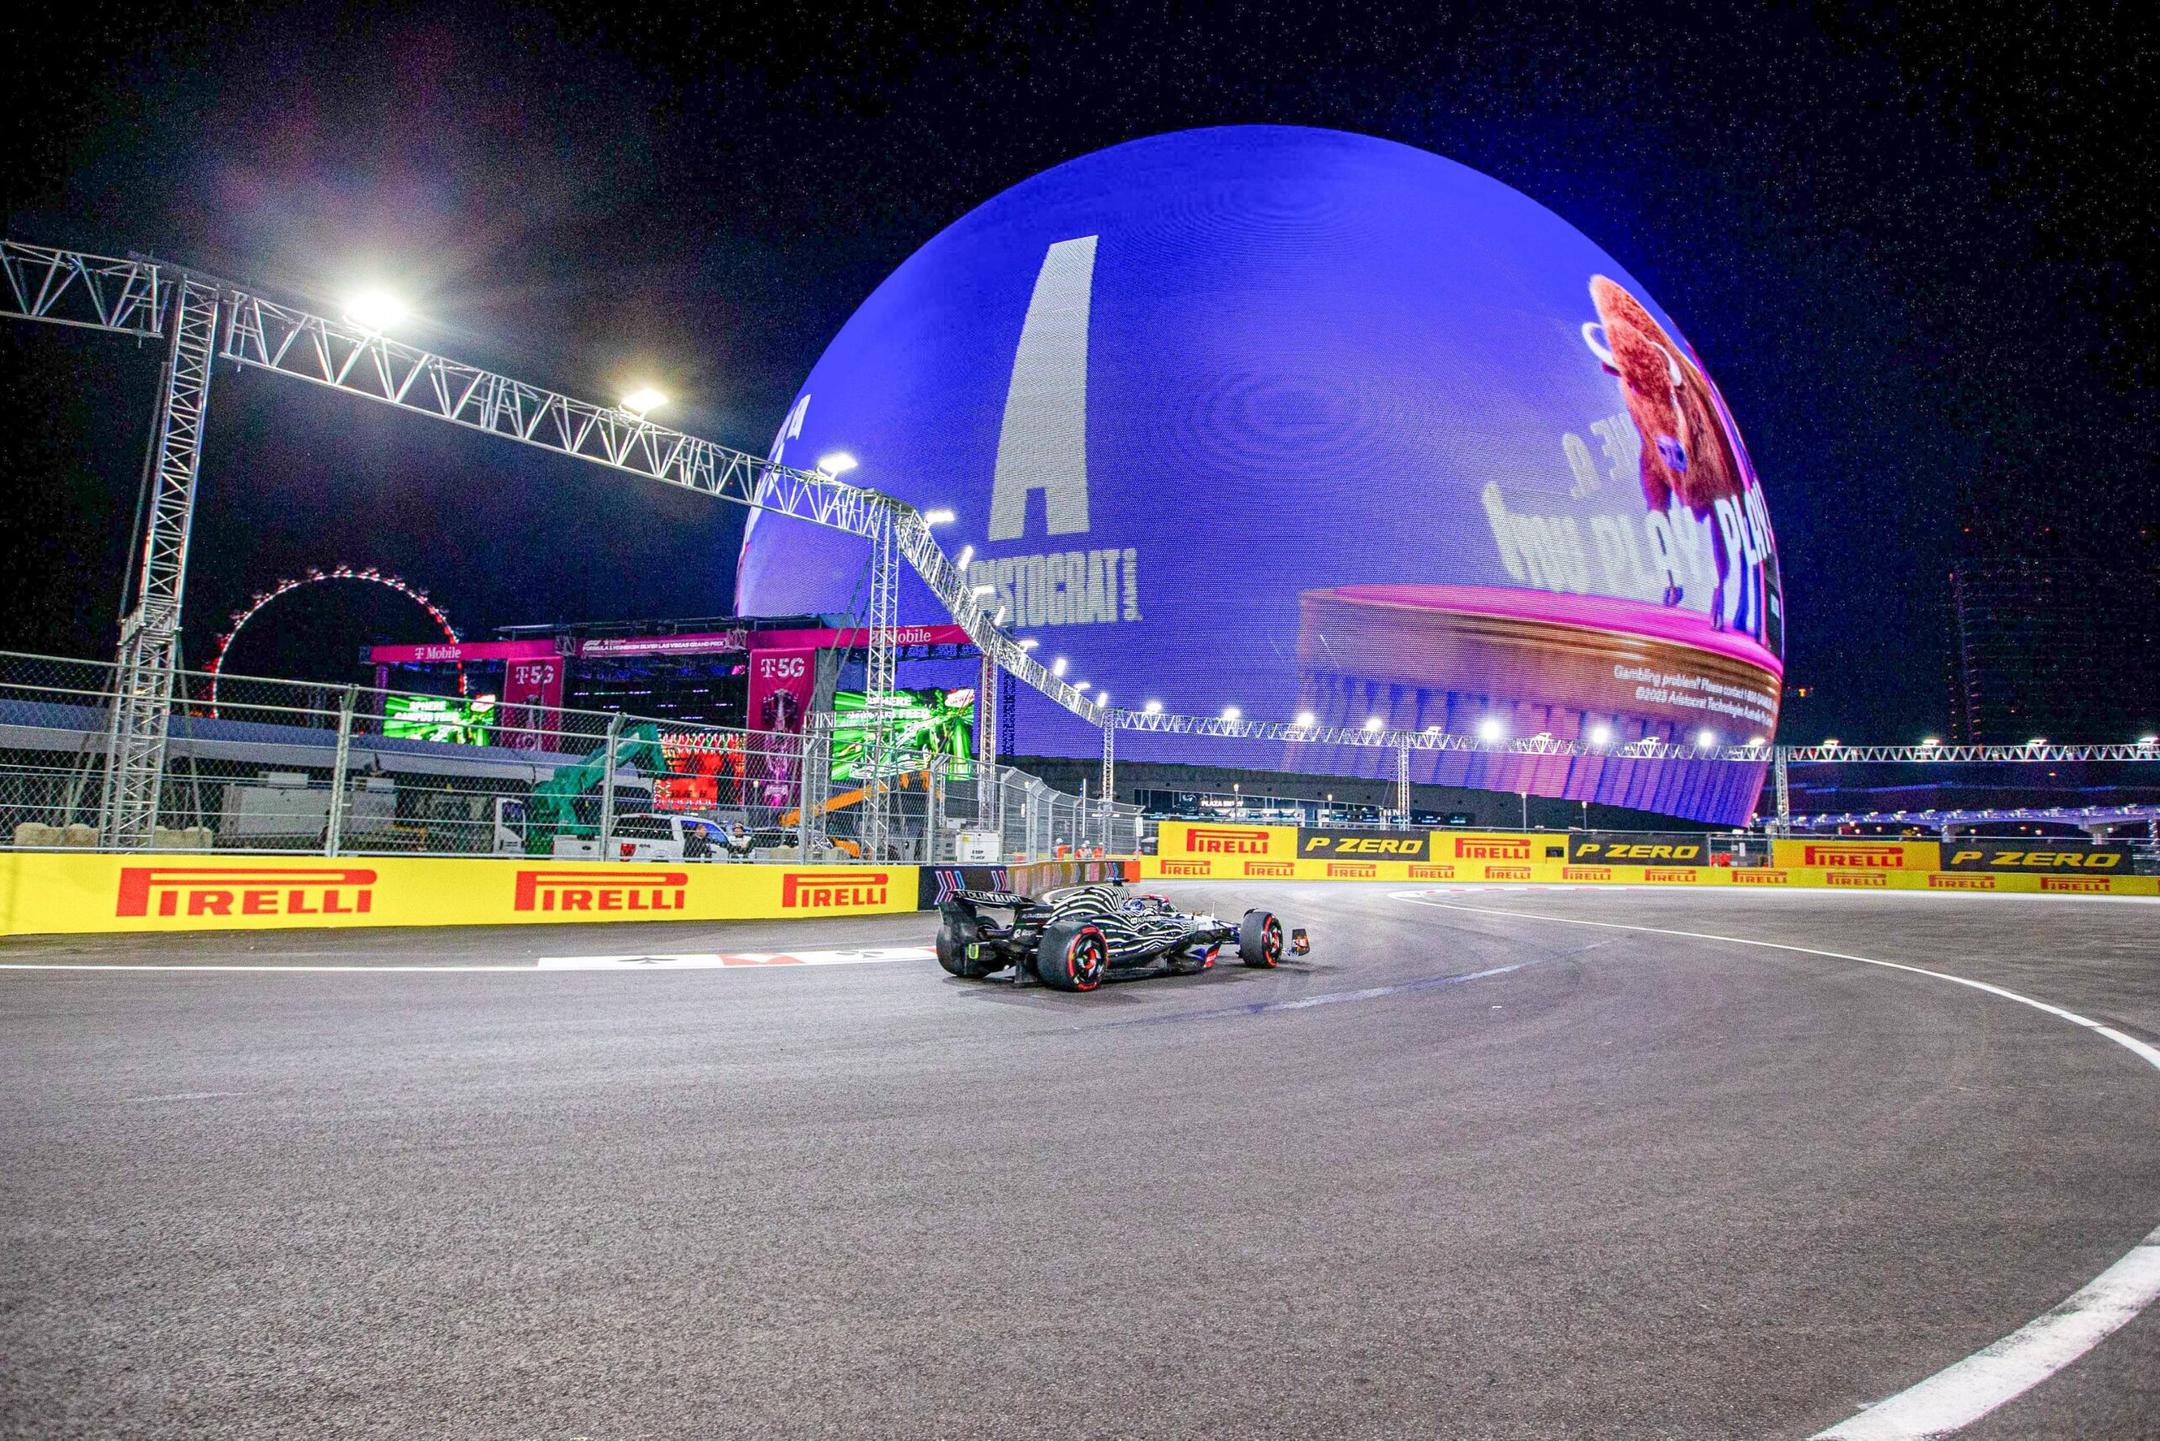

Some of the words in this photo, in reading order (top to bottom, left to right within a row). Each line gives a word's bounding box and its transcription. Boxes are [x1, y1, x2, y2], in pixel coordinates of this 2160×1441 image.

[962, 549, 1121, 627] RISTOCRAT
[1614, 664, 1662, 687] Gambling
[1187, 828, 1269, 854] PIRELLI
[1306, 837, 1331, 852] P
[1334, 838, 1424, 854] ZERO
[1456, 837, 1531, 859] PIRELLI
[1577, 843, 1601, 857] P
[1605, 844, 1700, 859] ZERO
[1804, 845, 1904, 868] PIRELLI
[1951, 851, 1983, 865] P
[1990, 852, 2121, 868] ZERO
[1161, 860, 1211, 875] PIRELLI
[1244, 861, 1294, 876] PIRELLI
[1327, 863, 1376, 878] PIRELLI
[1408, 864, 1454, 879] PIRELLI
[1485, 866, 1531, 879] PIRELLI
[1563, 867, 1611, 880] PIRELLI
[1645, 868, 1697, 882] PIRELLI
[1732, 870, 1787, 883] PIRELLI
[1826, 872, 1887, 886] PIRELLI
[1928, 874, 1995, 889] PIRELLI
[2040, 876, 2110, 891] PIRELLI
[116, 868, 378, 917] PIRELLI
[514, 870, 689, 911] PIRELLI
[783, 873, 888, 908] PIRELLI
